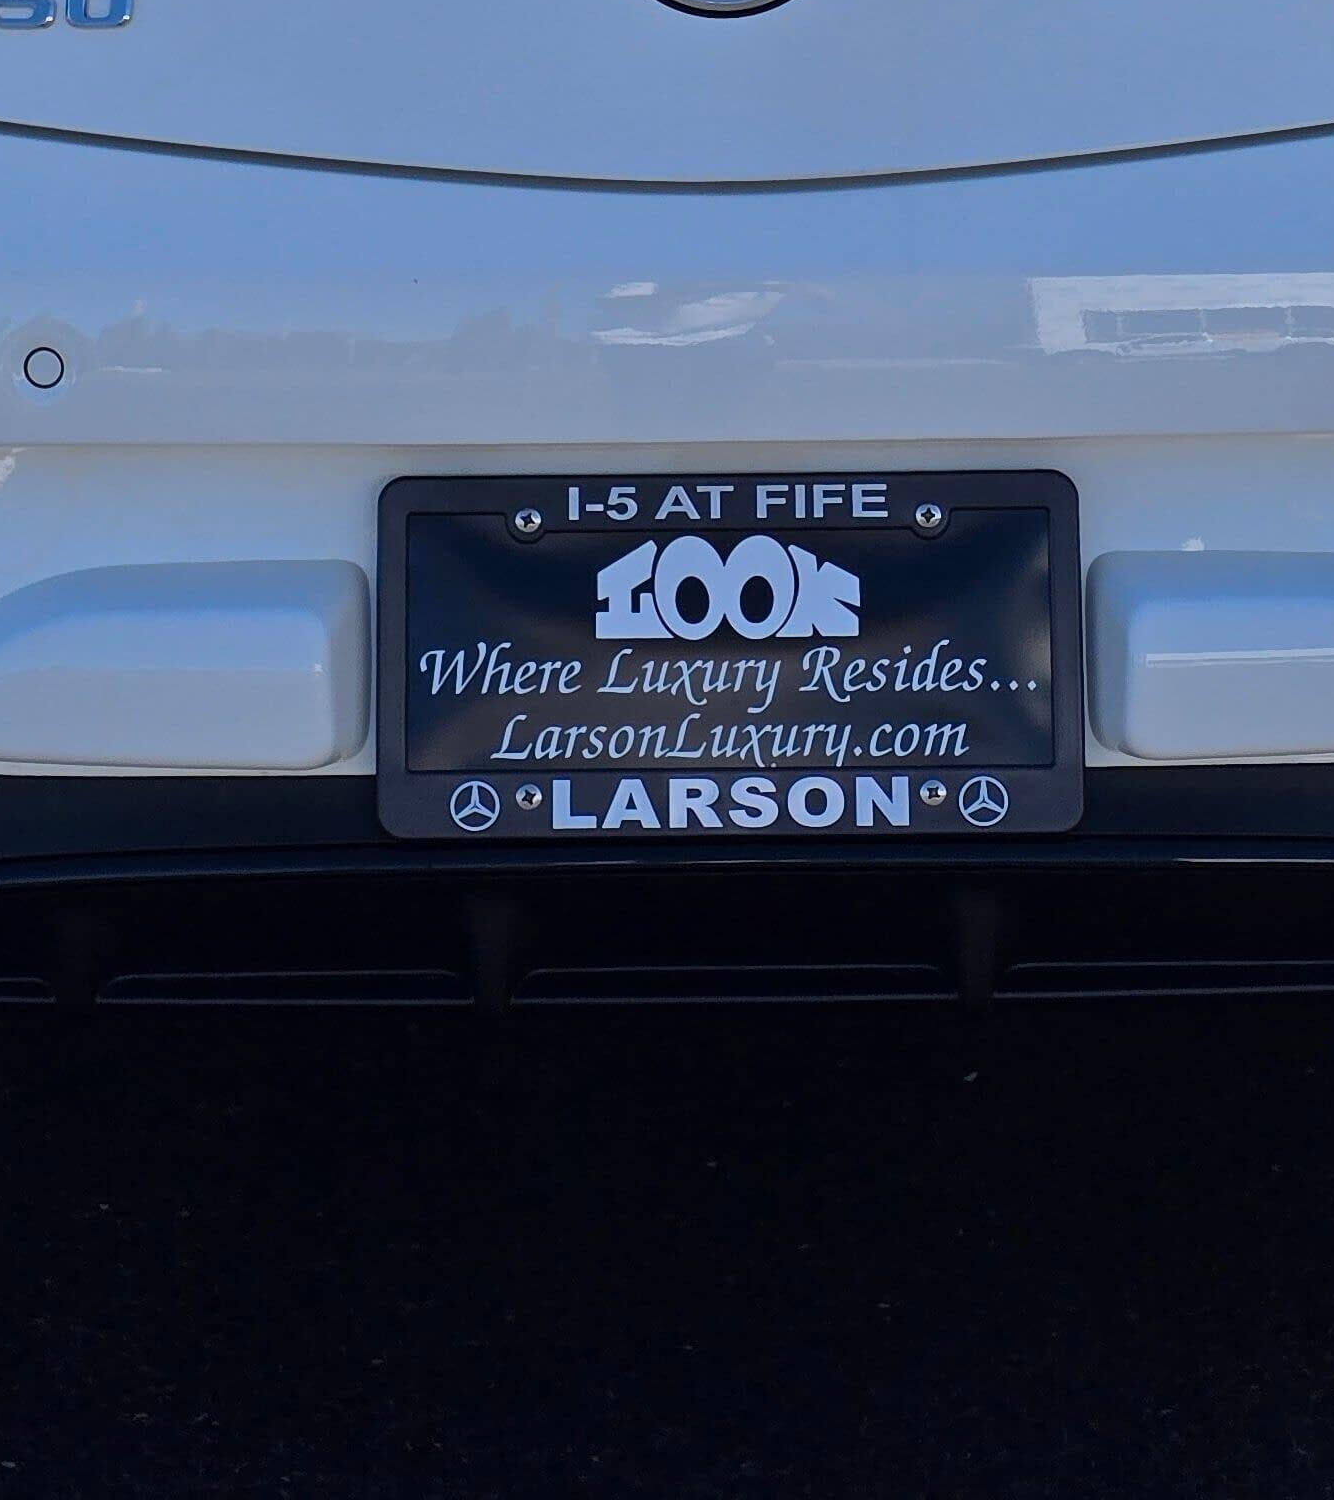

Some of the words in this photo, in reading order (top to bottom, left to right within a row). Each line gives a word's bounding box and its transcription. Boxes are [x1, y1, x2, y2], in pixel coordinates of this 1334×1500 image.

[568, 486, 638, 522] I-5
[655, 485, 735, 520] AT
[756, 483, 889, 519] FIFE
[419, 641, 582, 696] Where
[596, 647, 780, 714] Luxury
[801, 639, 1038, 702] Resides...
[490, 712, 970, 768] LarsonLuxury.com
[551, 776, 910, 831] LARSON
